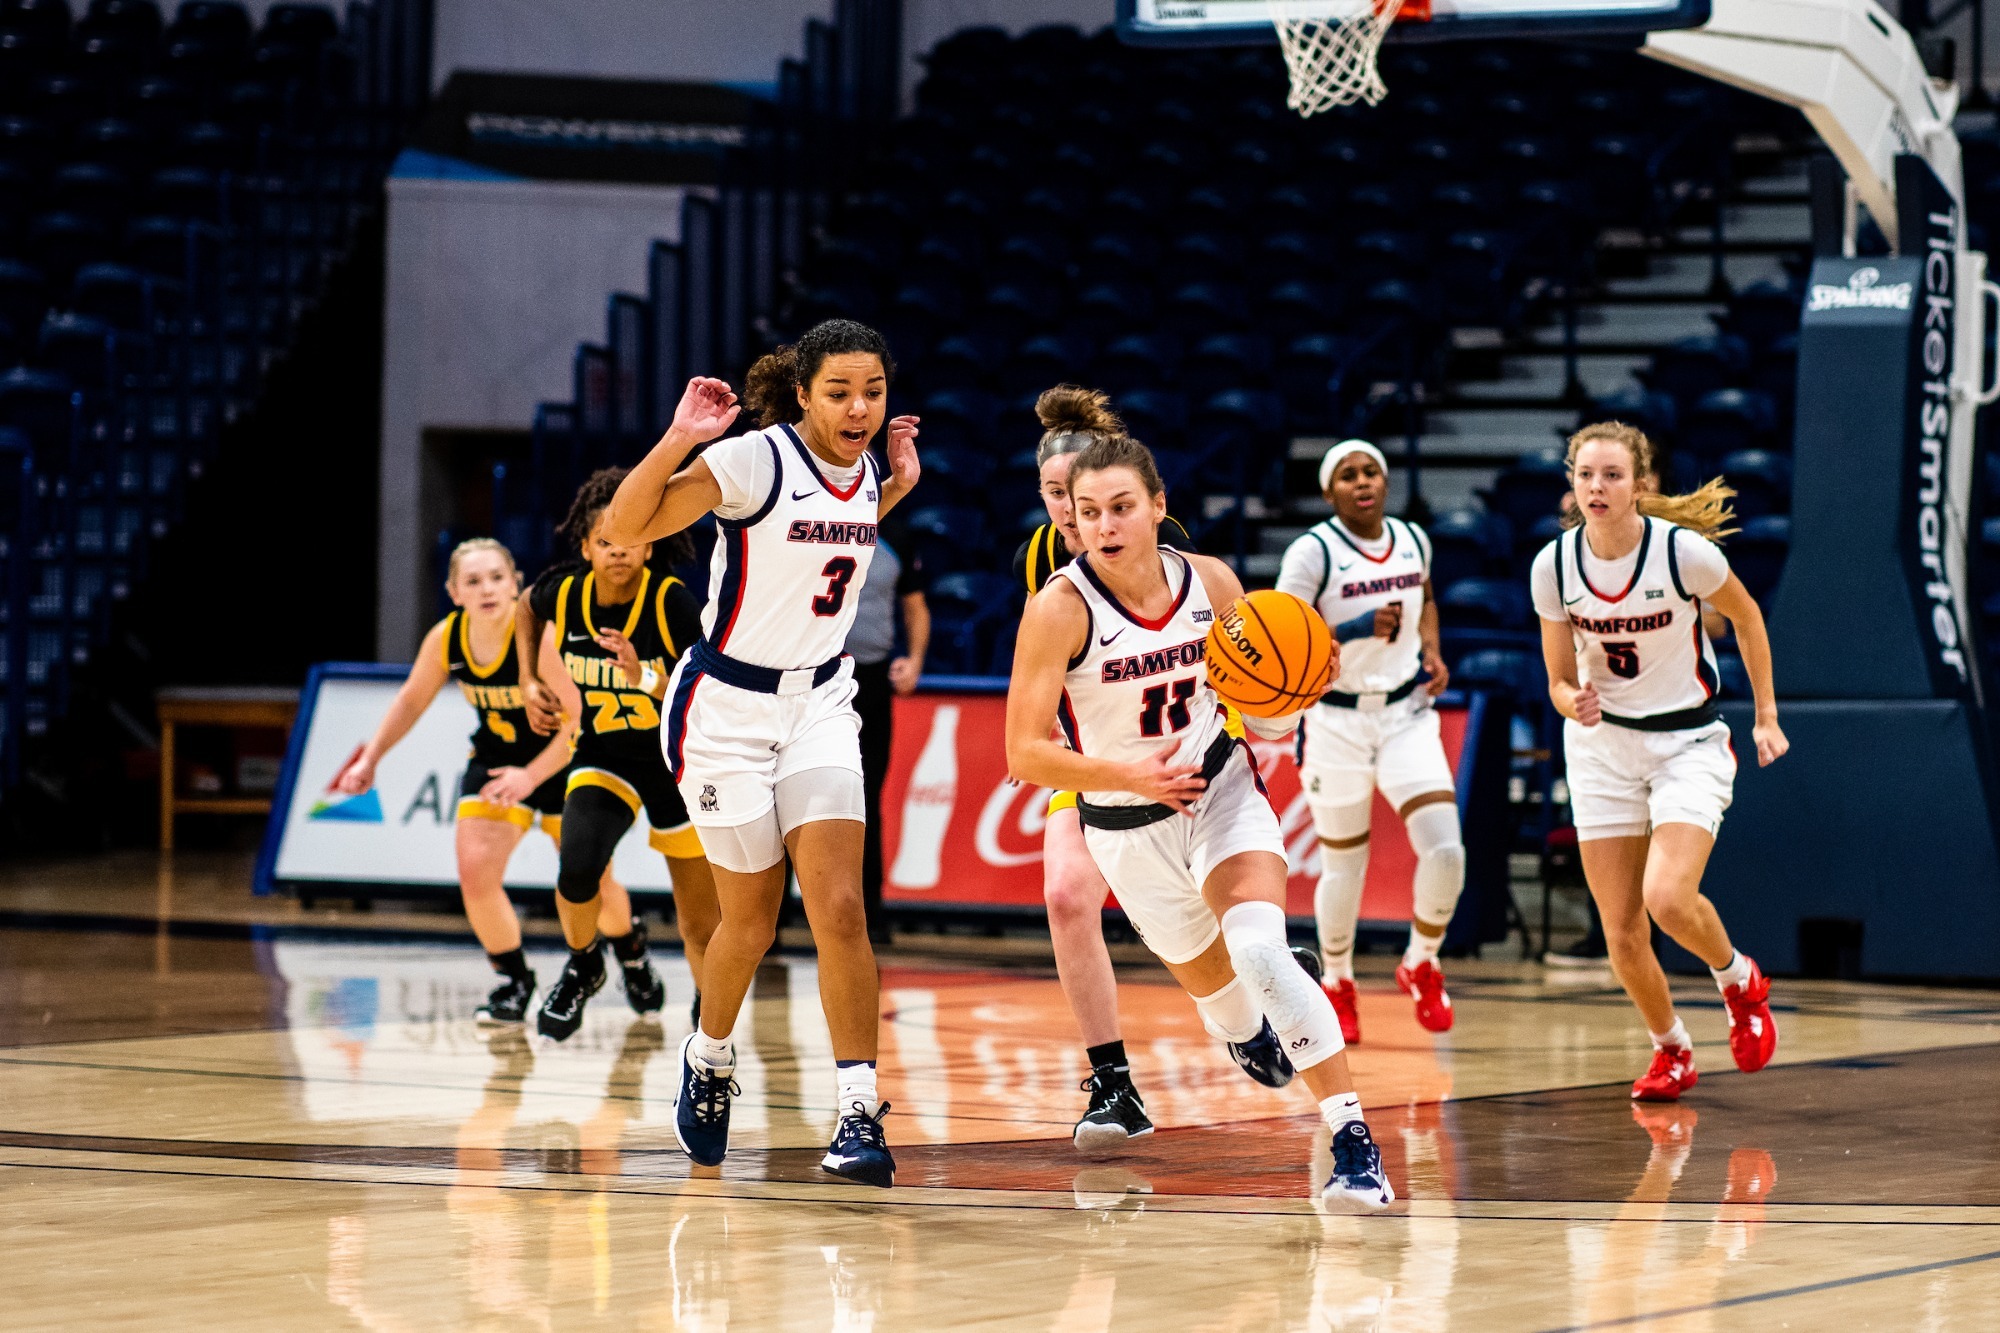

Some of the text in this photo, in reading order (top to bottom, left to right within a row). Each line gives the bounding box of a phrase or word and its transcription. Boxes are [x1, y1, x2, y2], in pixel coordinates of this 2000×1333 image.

[1808, 282, 1912, 311] SPALDING
[786, 519, 878, 547] SAMFOR
[811, 555, 858, 617] 3
[1101, 636, 1207, 684] SAMFOR
[1600, 641, 1639, 680] 5
[585, 690, 660, 735] 23
[1140, 675, 1197, 738] 11
